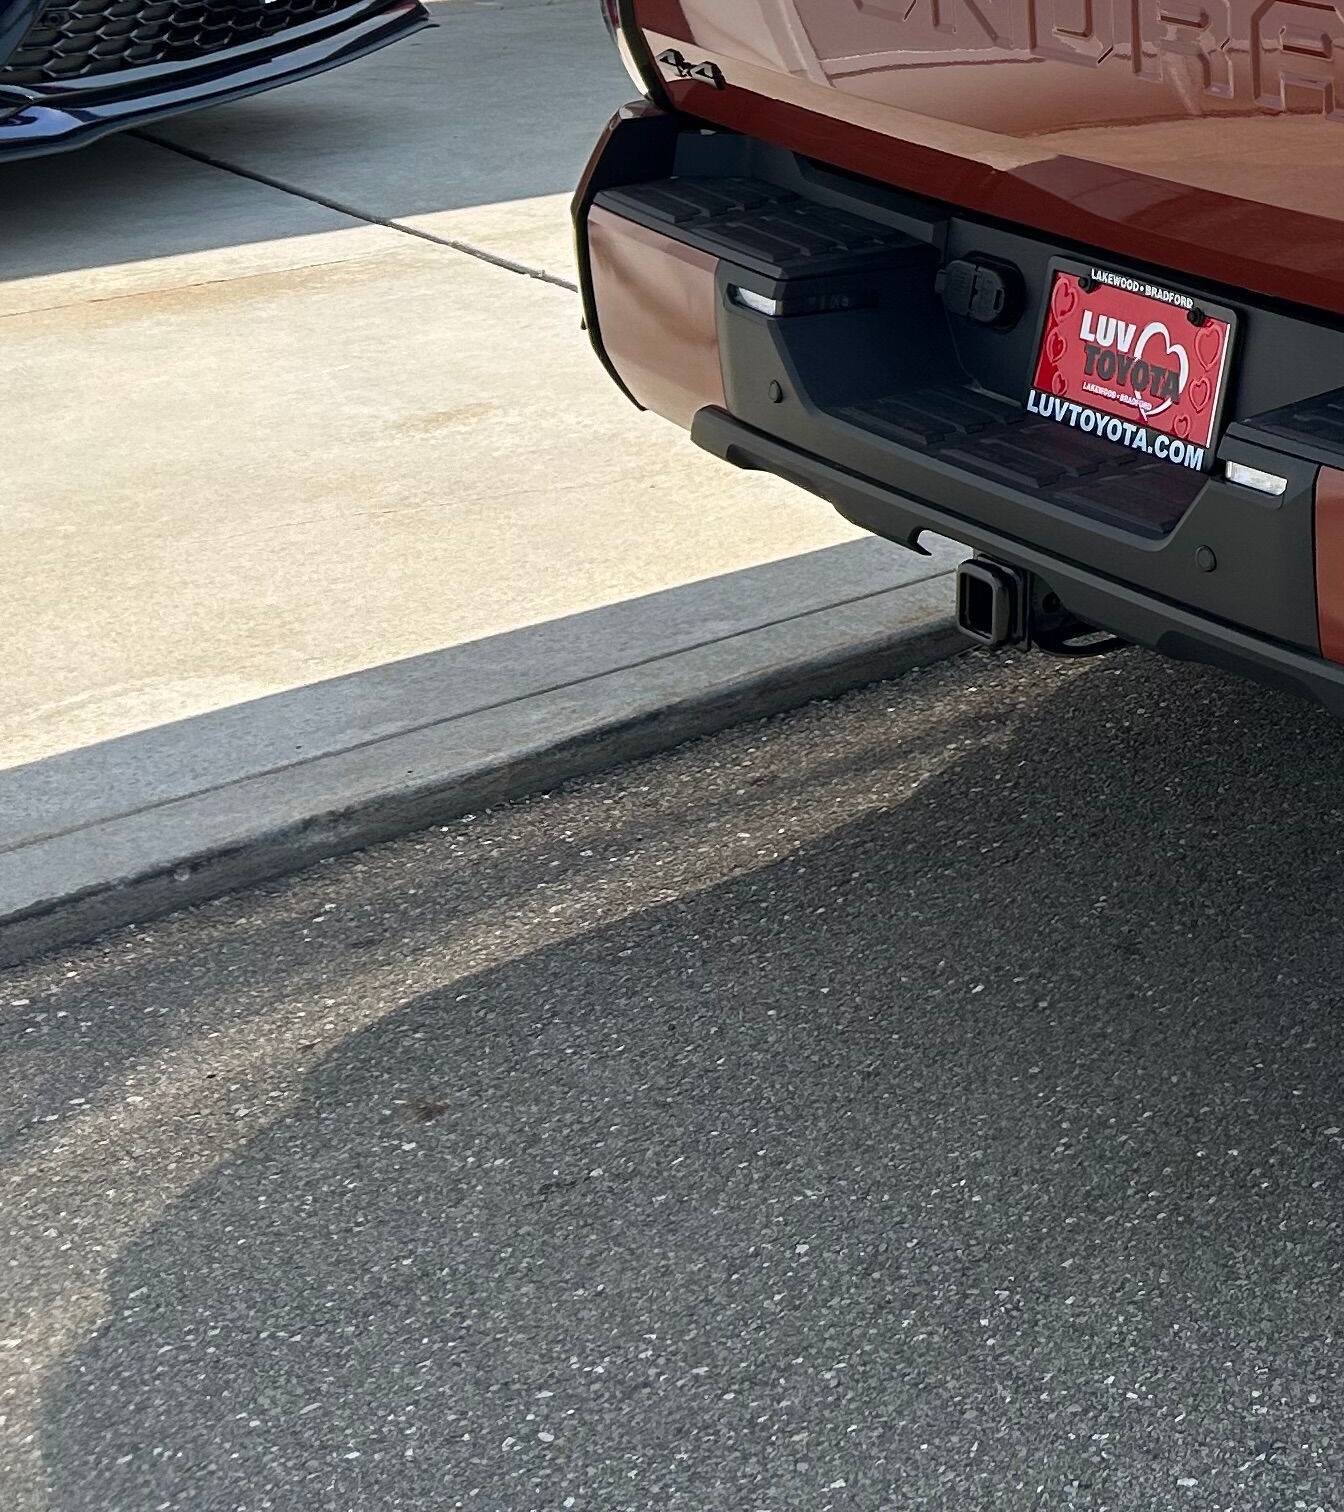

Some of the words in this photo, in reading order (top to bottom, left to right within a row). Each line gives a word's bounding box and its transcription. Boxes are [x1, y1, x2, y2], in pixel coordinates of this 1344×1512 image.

[656, 48, 727, 90] 4x4
[1091, 268, 1139, 292] LAKEWOOD
[1145, 285, 1194, 309] BRADFORD
[1079, 309, 1136, 354] LUV
[1082, 381, 1117, 399] LAKEWOOD
[1083, 343, 1181, 403] TOYOTA
[1026, 389, 1204, 472] LUVTOYOTA.COM
